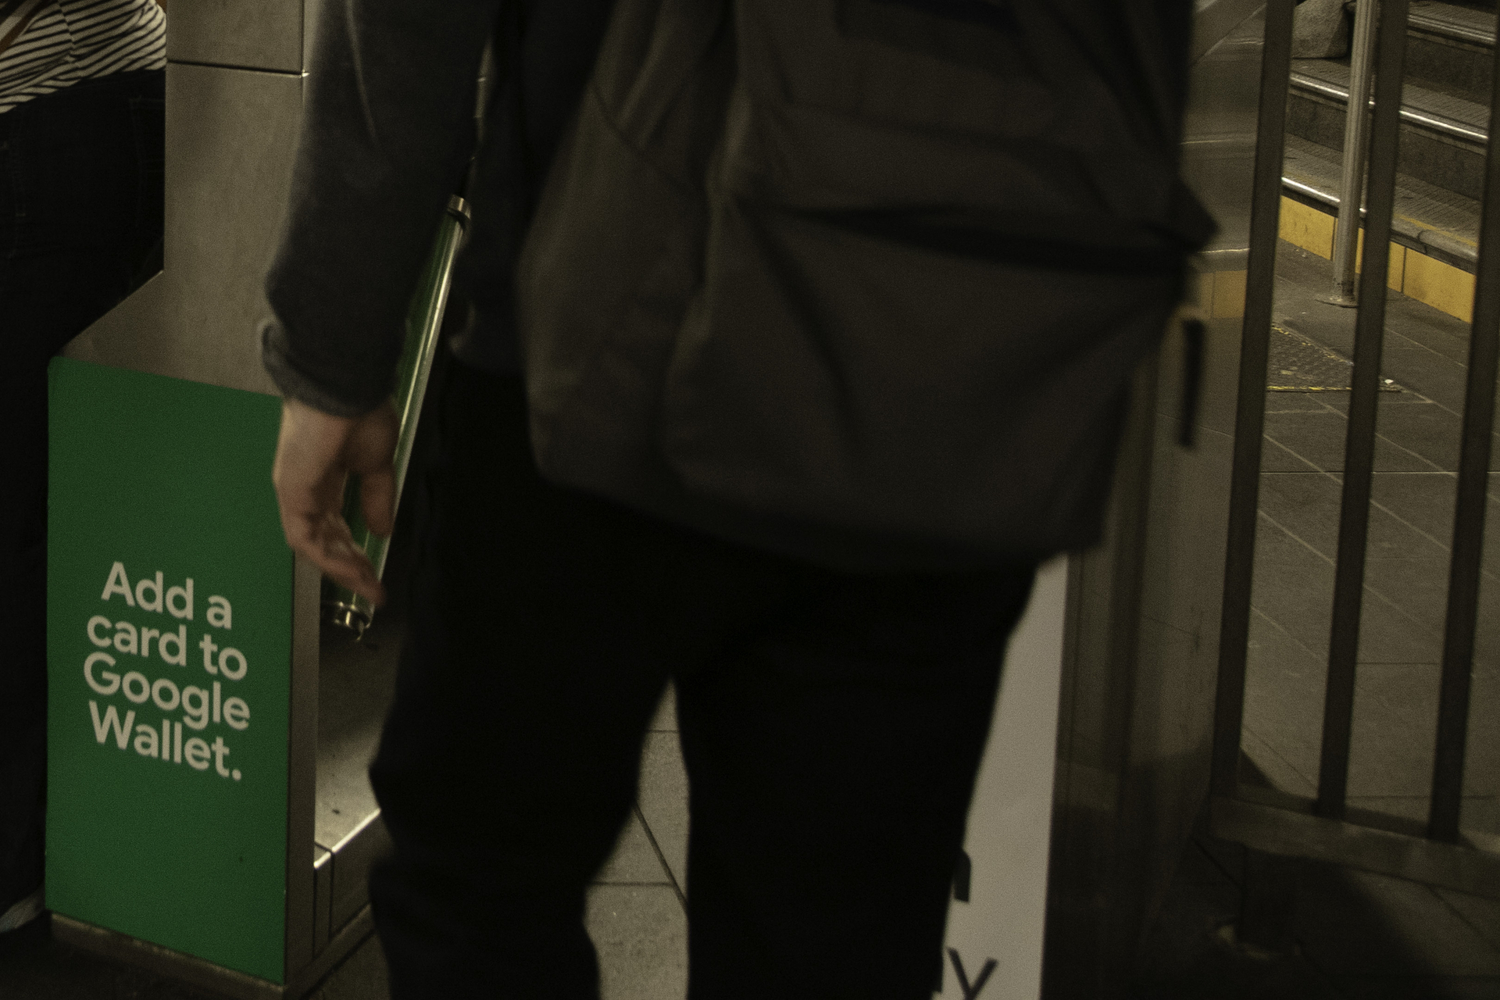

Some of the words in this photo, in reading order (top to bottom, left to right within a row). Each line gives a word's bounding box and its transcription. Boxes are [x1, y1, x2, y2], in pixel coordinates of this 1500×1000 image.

[101, 561, 194, 621] Add
[206, 595, 232, 630] a
[87, 615, 187, 667] card
[199, 633, 248, 681] to
[83, 651, 251, 731] Google
[88, 700, 242, 782] Wallet.
